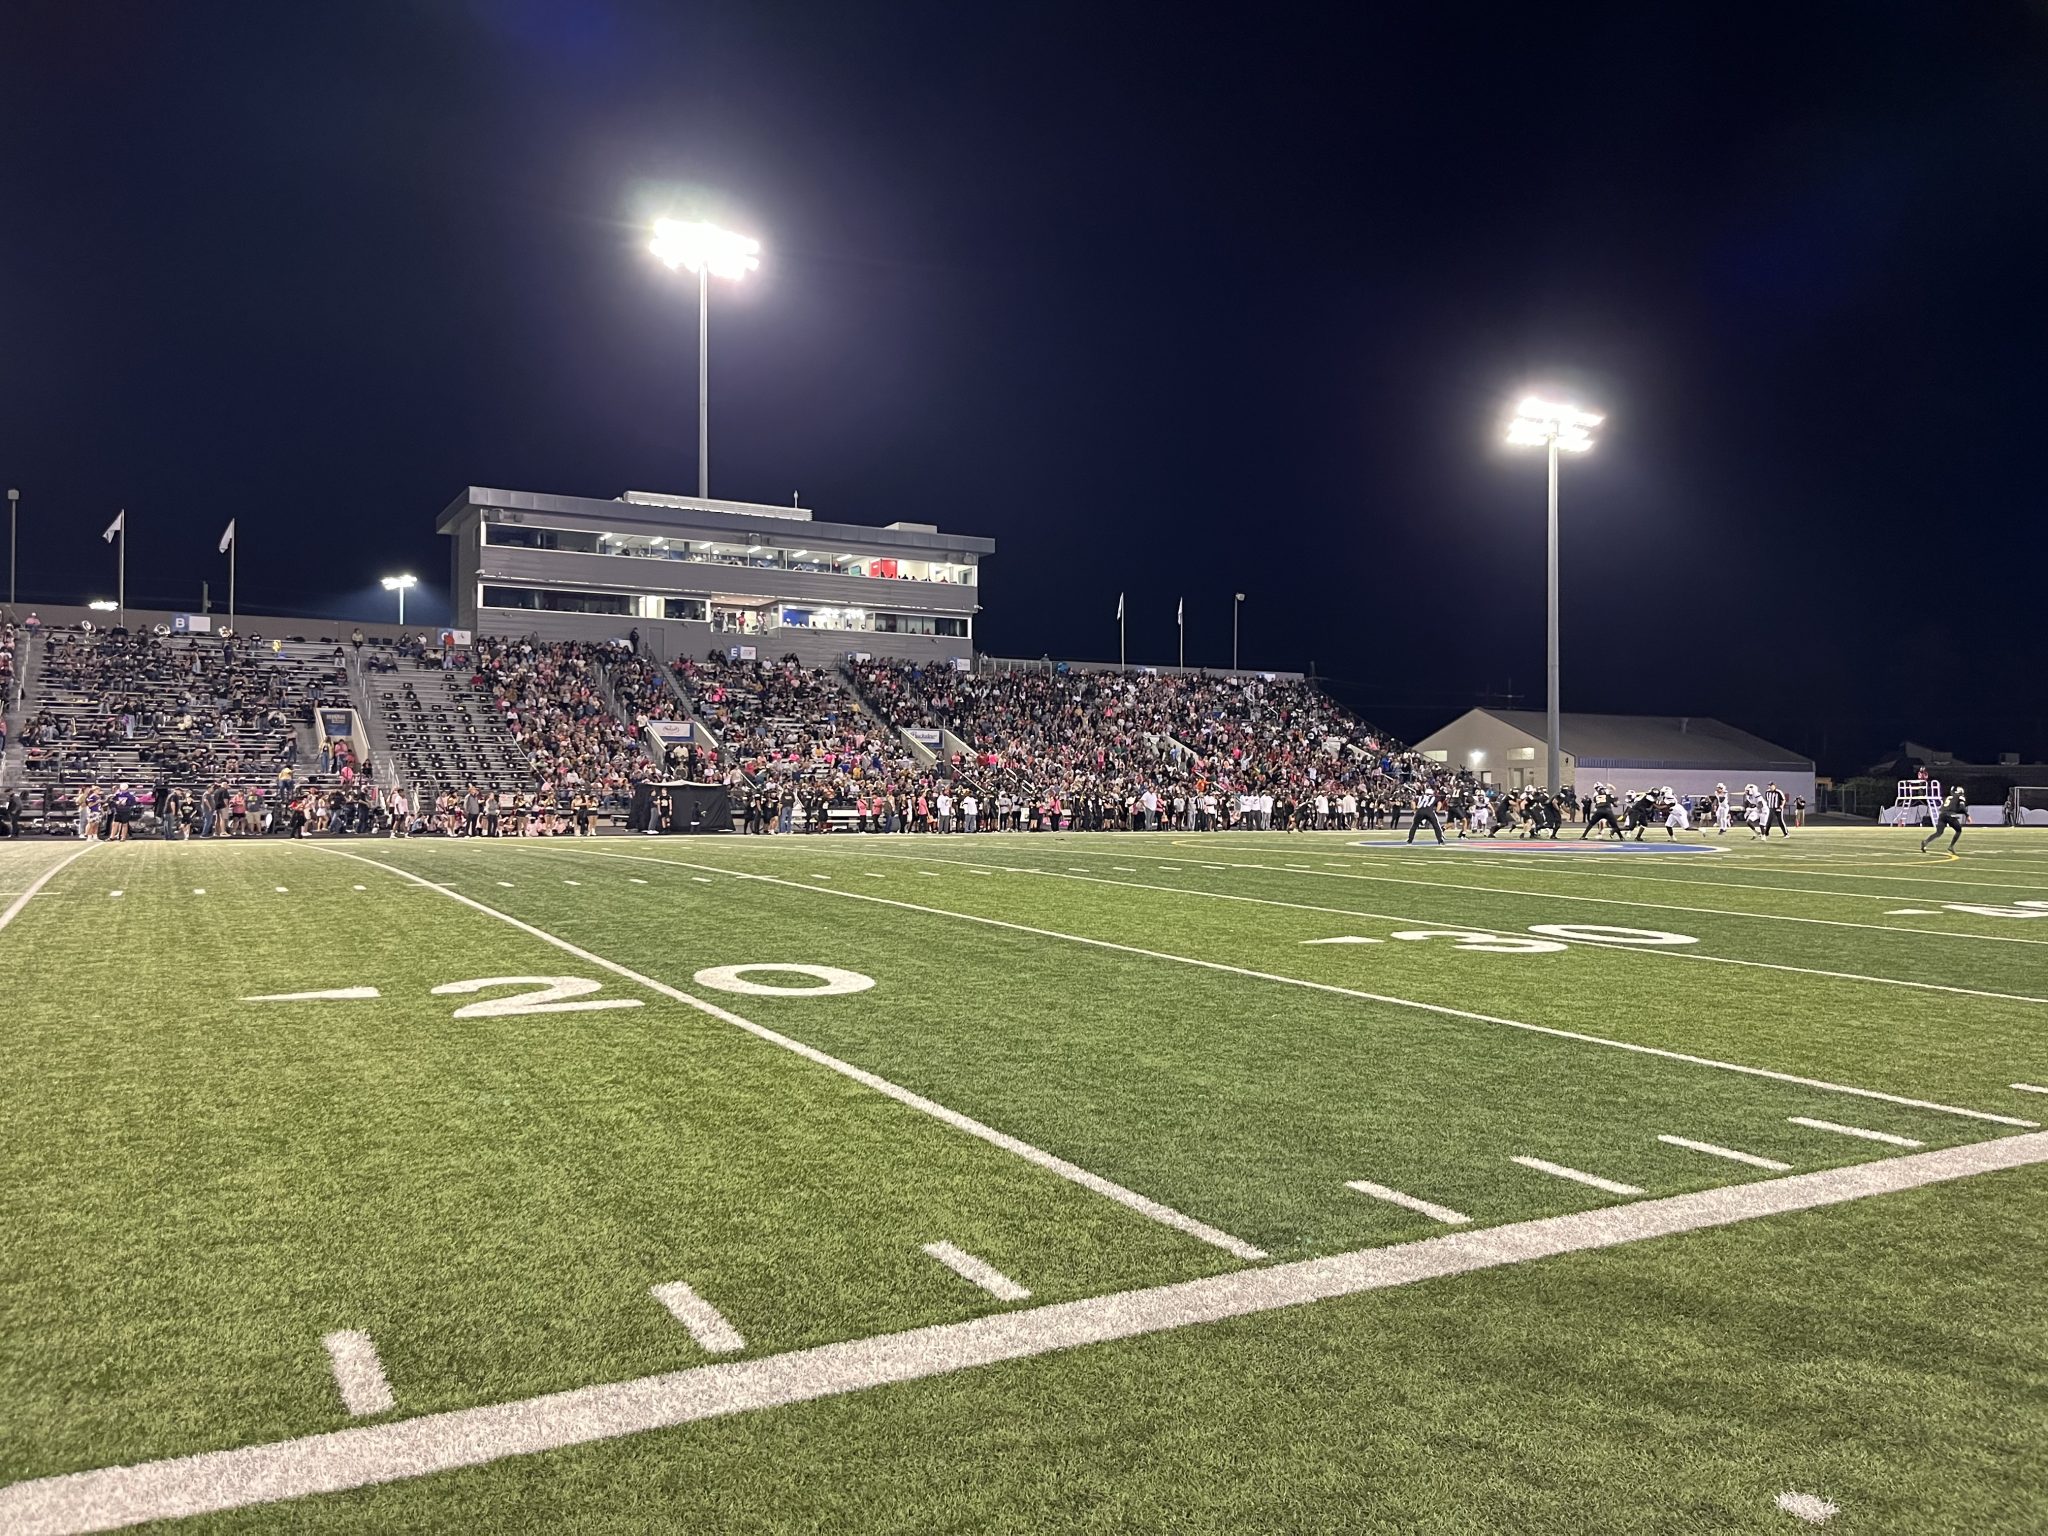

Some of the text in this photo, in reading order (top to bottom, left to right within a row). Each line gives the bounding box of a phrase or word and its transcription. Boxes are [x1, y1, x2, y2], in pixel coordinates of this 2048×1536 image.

[175, 617, 185, 628] B
[730, 647, 738, 657] E
[1391, 924, 1698, 953] 30
[431, 962, 876, 1018] 20
